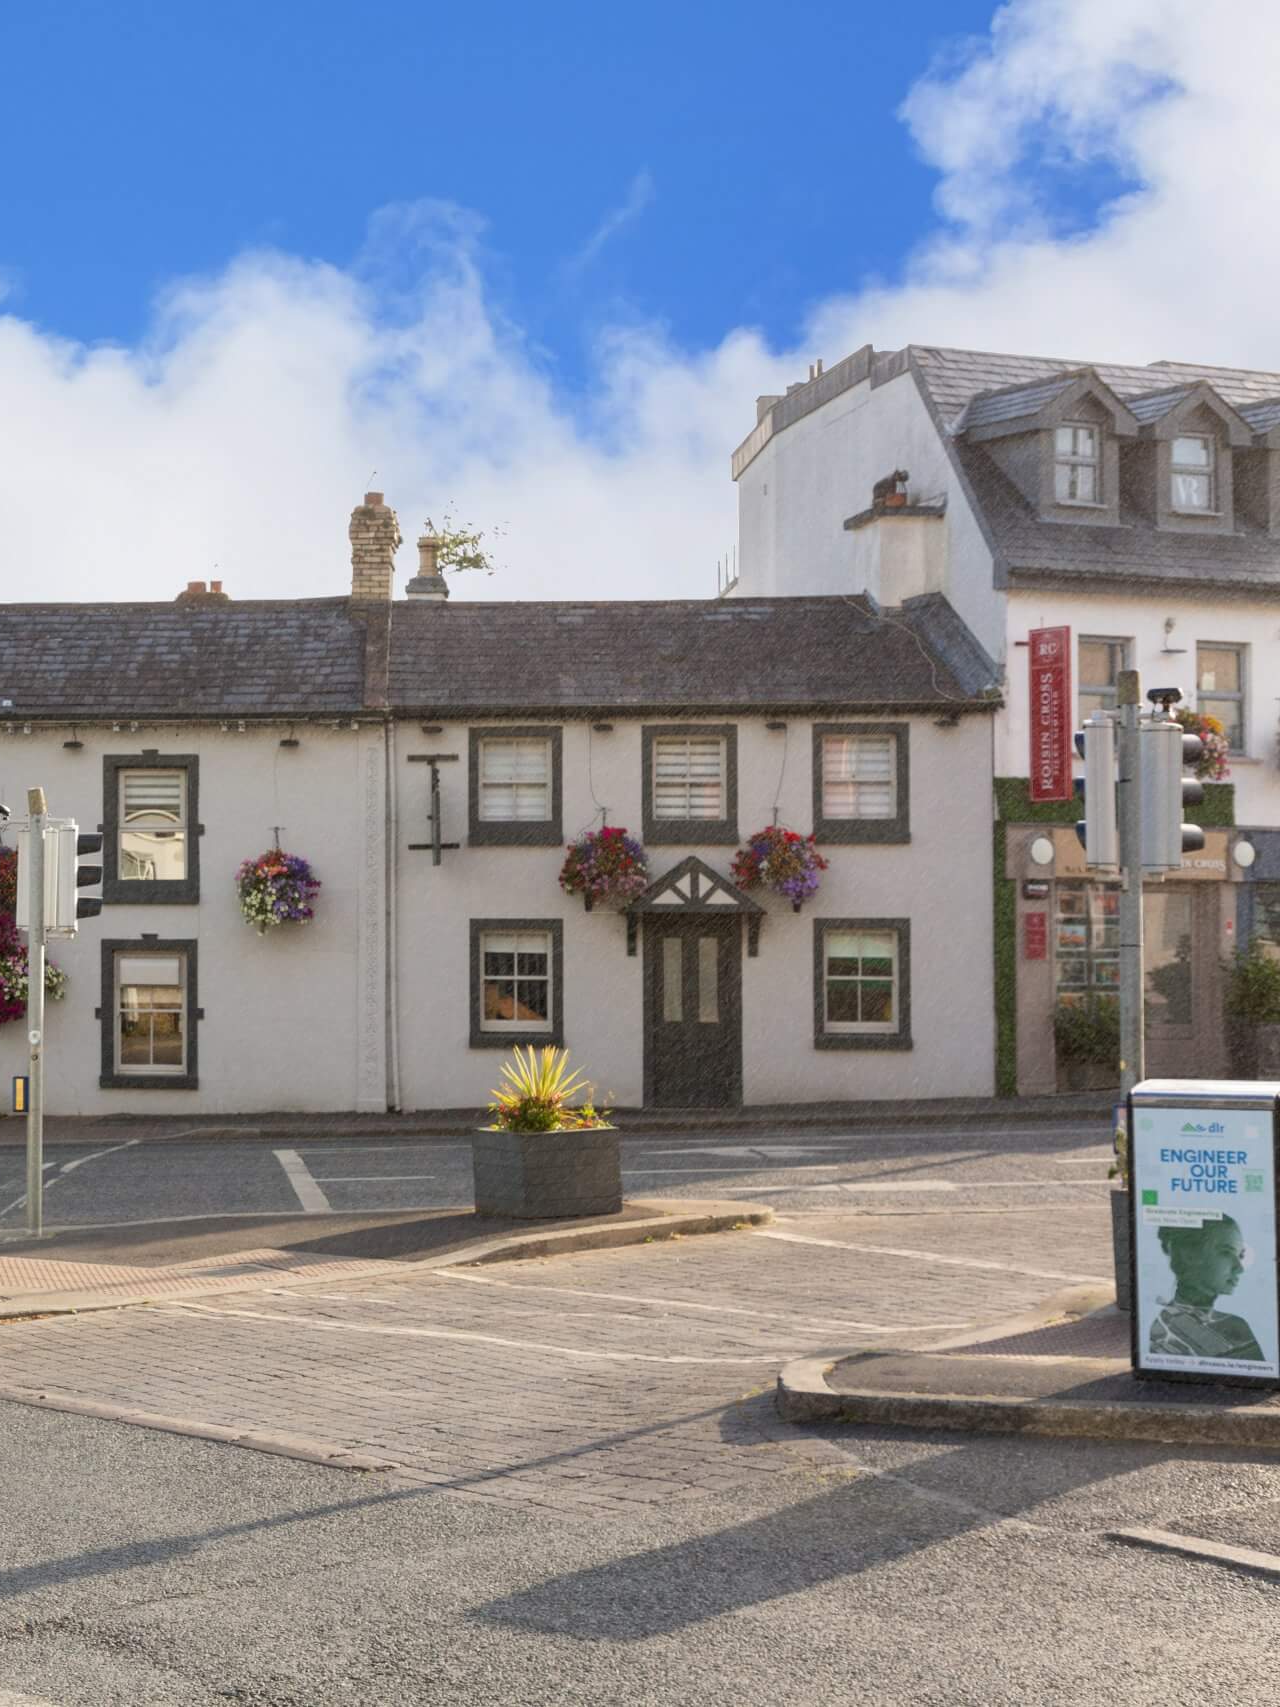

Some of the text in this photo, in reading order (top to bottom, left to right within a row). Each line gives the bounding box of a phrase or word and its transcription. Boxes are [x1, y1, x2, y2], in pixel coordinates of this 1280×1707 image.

[1039, 643, 1056, 656] RC
[1040, 672, 1054, 790] ROISIN CROSS
[1208, 1122, 1225, 1133] dlr
[1160, 1148, 1248, 1164] ENGINEER
[1190, 1164, 1228, 1178] OUR
[1170, 1178, 1238, 1194] FUTURE
